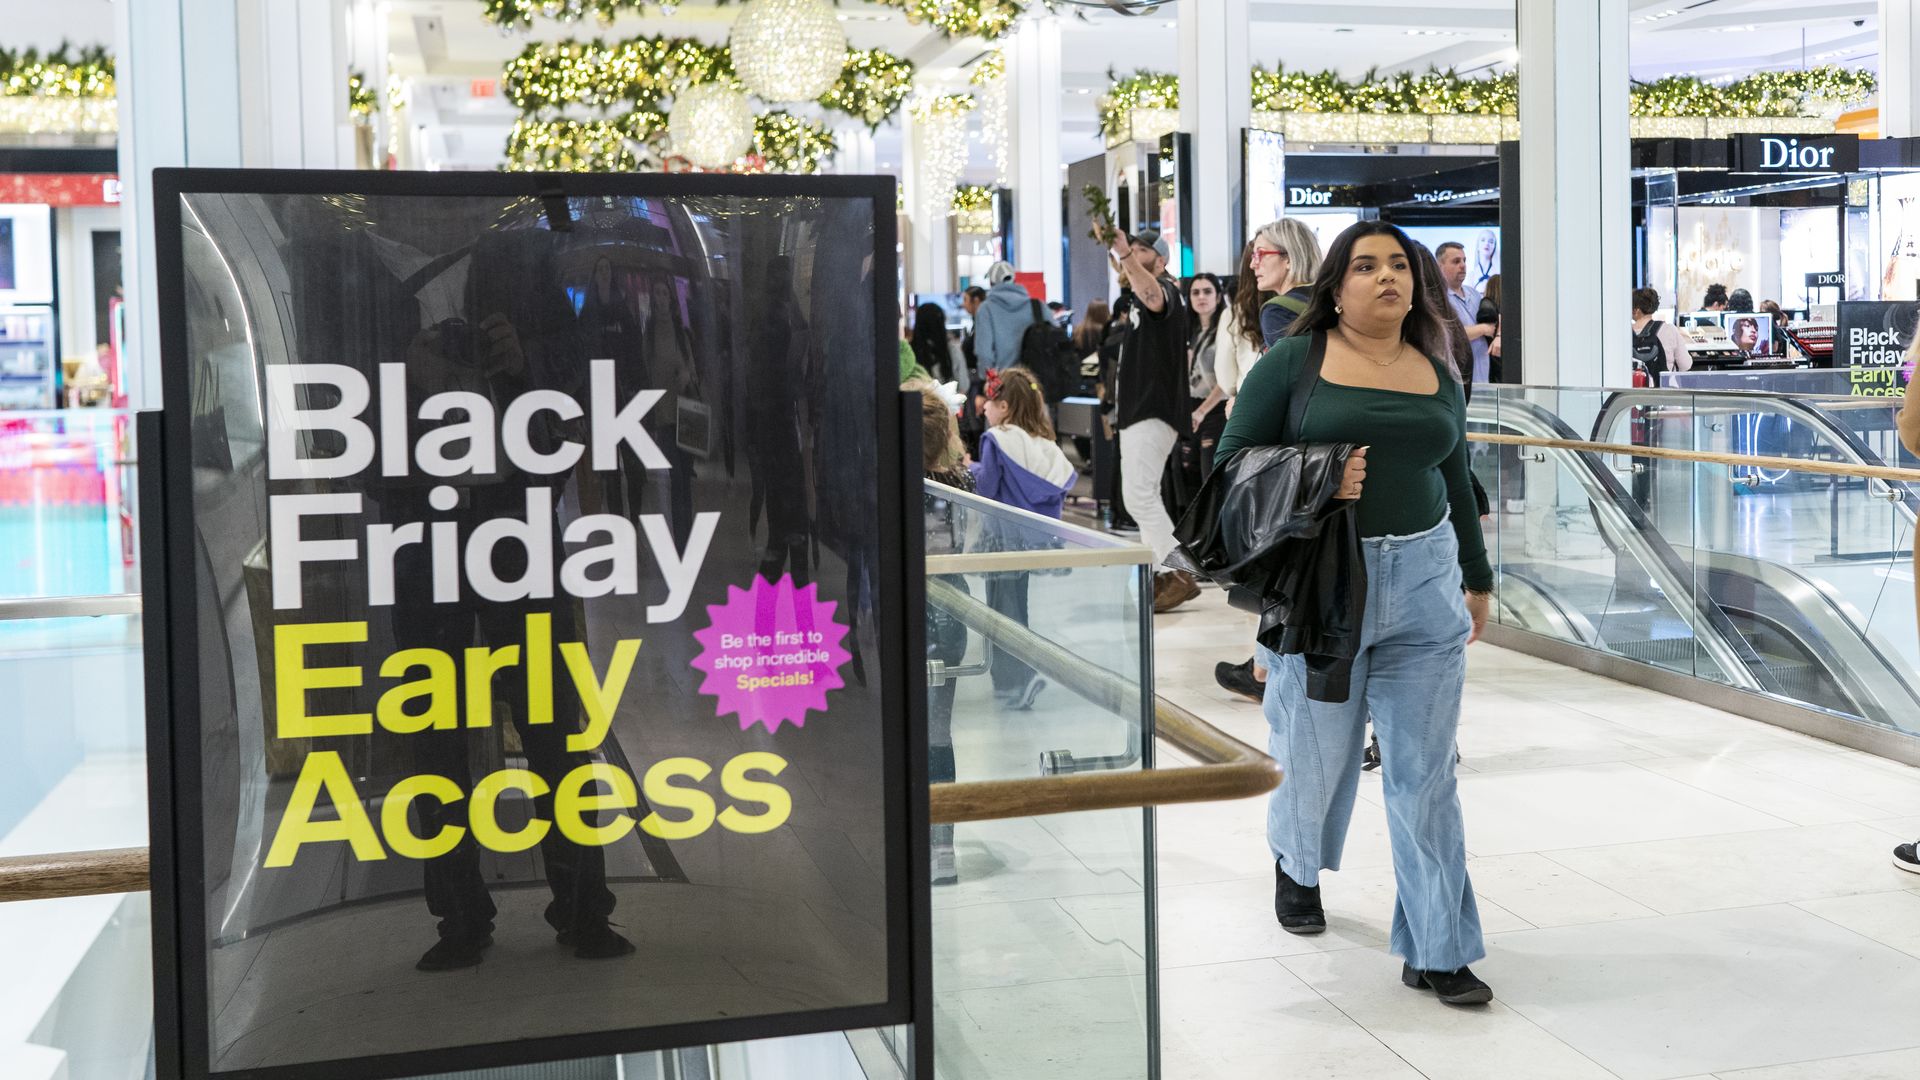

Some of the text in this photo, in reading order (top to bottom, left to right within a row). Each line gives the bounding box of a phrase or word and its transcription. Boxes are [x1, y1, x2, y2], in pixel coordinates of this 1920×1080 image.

[1760, 137, 1834, 168] Dior
[1289, 188, 1332, 205] Dior
[1818, 274, 1845, 284] DIOR
[1850, 327, 1900, 346] Black
[1850, 346, 1906, 368] Friday
[1850, 365, 1894, 386] Early
[1851, 384, 1905, 398] Acces
[266, 359, 672, 480] Black
[269, 485, 721, 624] Friday
[721, 630, 823, 649] Be the first to
[714, 649, 829, 670] shop incredible
[273, 612, 642, 752] Early
[736, 670, 814, 692] Specials!
[263, 751, 792, 868] Access
